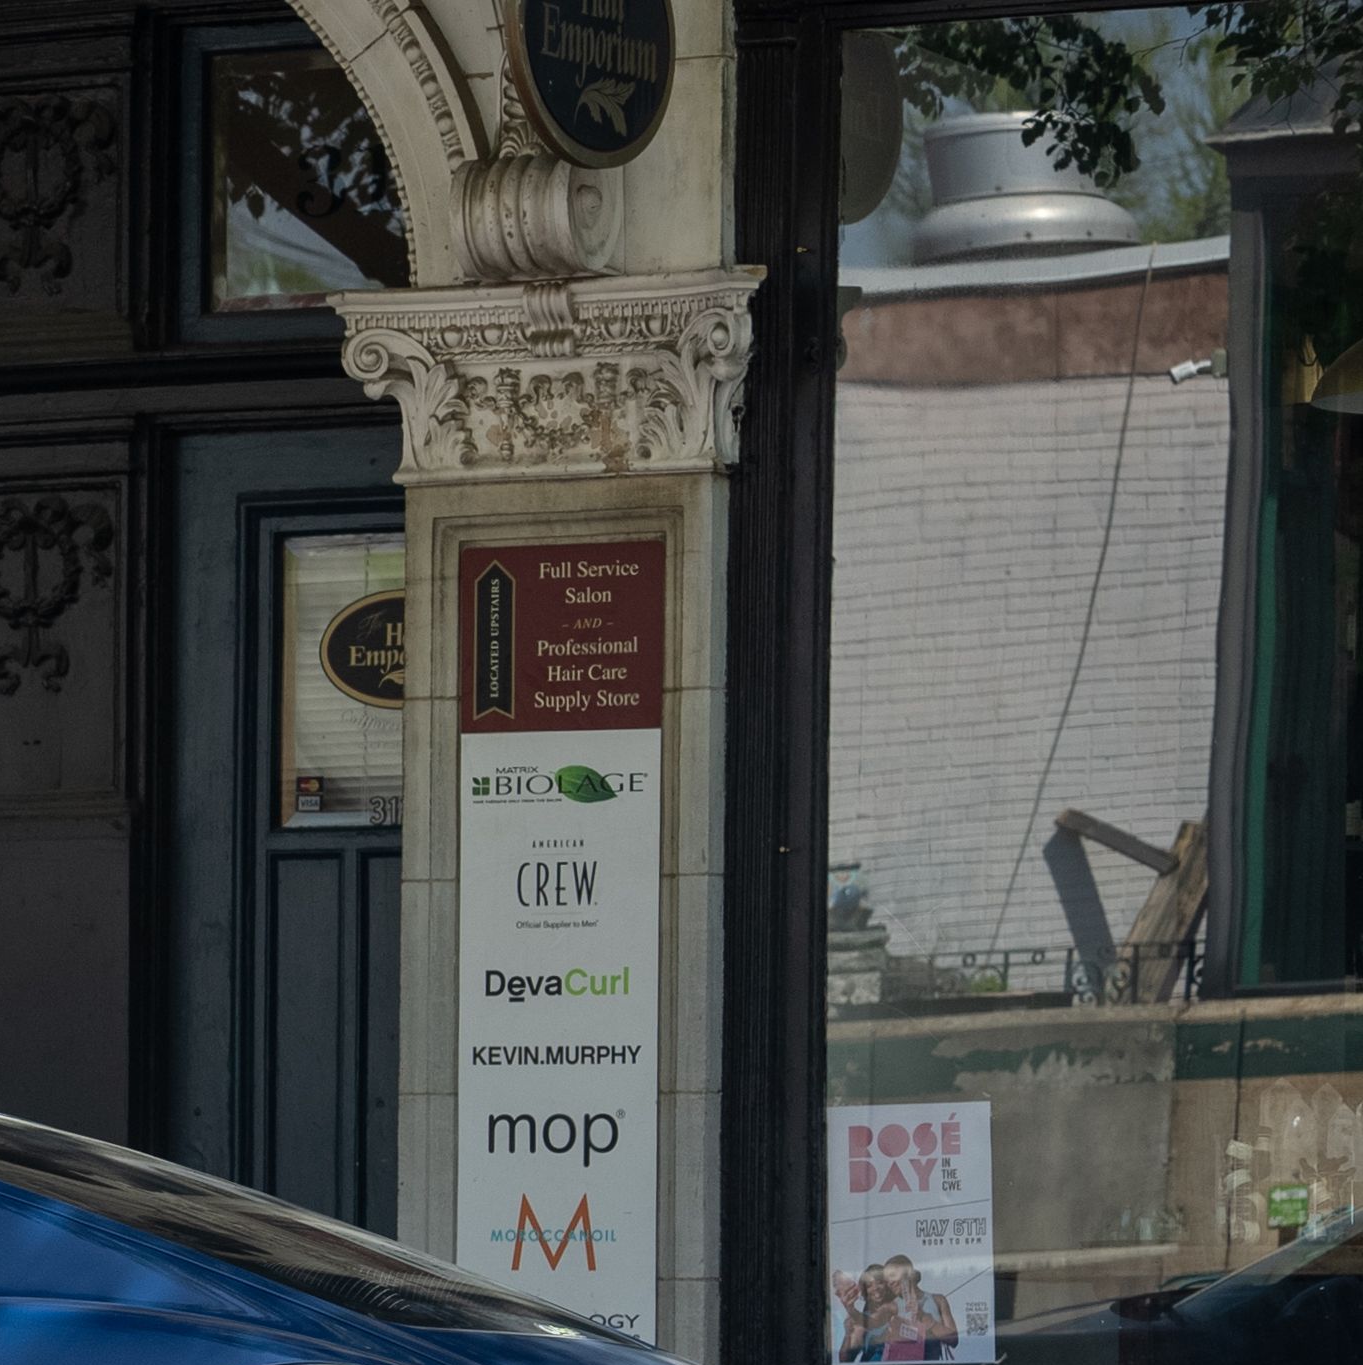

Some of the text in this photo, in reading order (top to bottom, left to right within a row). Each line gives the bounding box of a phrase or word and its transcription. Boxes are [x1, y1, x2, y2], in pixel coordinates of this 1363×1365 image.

[540, 1, 658, 88] Emporium
[538, 559, 640, 580] Full Service
[564, 586, 613, 605] Salon
[574, 617, 602, 630] AND
[489, 578, 500, 698] LOCATED UPSTAIRS
[537, 636, 639, 657] Professional
[546, 663, 628, 682] Hair Care
[534, 689, 640, 712] Supply Store
[495, 766, 539, 774] MATRIX
[495, 772, 645, 796] BIOLAGE
[299, 799, 320, 808] VISA
[532, 840, 585, 849] AMERICAN
[517, 861, 598, 907] CREW
[516, 920, 542, 929] Official
[543, 920, 571, 930] Supplier
[485, 966, 630, 1001] DevaCurl
[472, 1044, 642, 1066] KEVIN.MURPHY
[848, 1112, 961, 1158] ROSÉ
[942, 1157, 951, 1168] IN
[849, 1158, 938, 1193] DAY
[942, 1169, 959, 1180] THE
[942, 1180, 962, 1192] CWE
[490, 1228, 617, 1243] MOROCCANOIL
[916, 1217, 987, 1238] MAY 6TH
